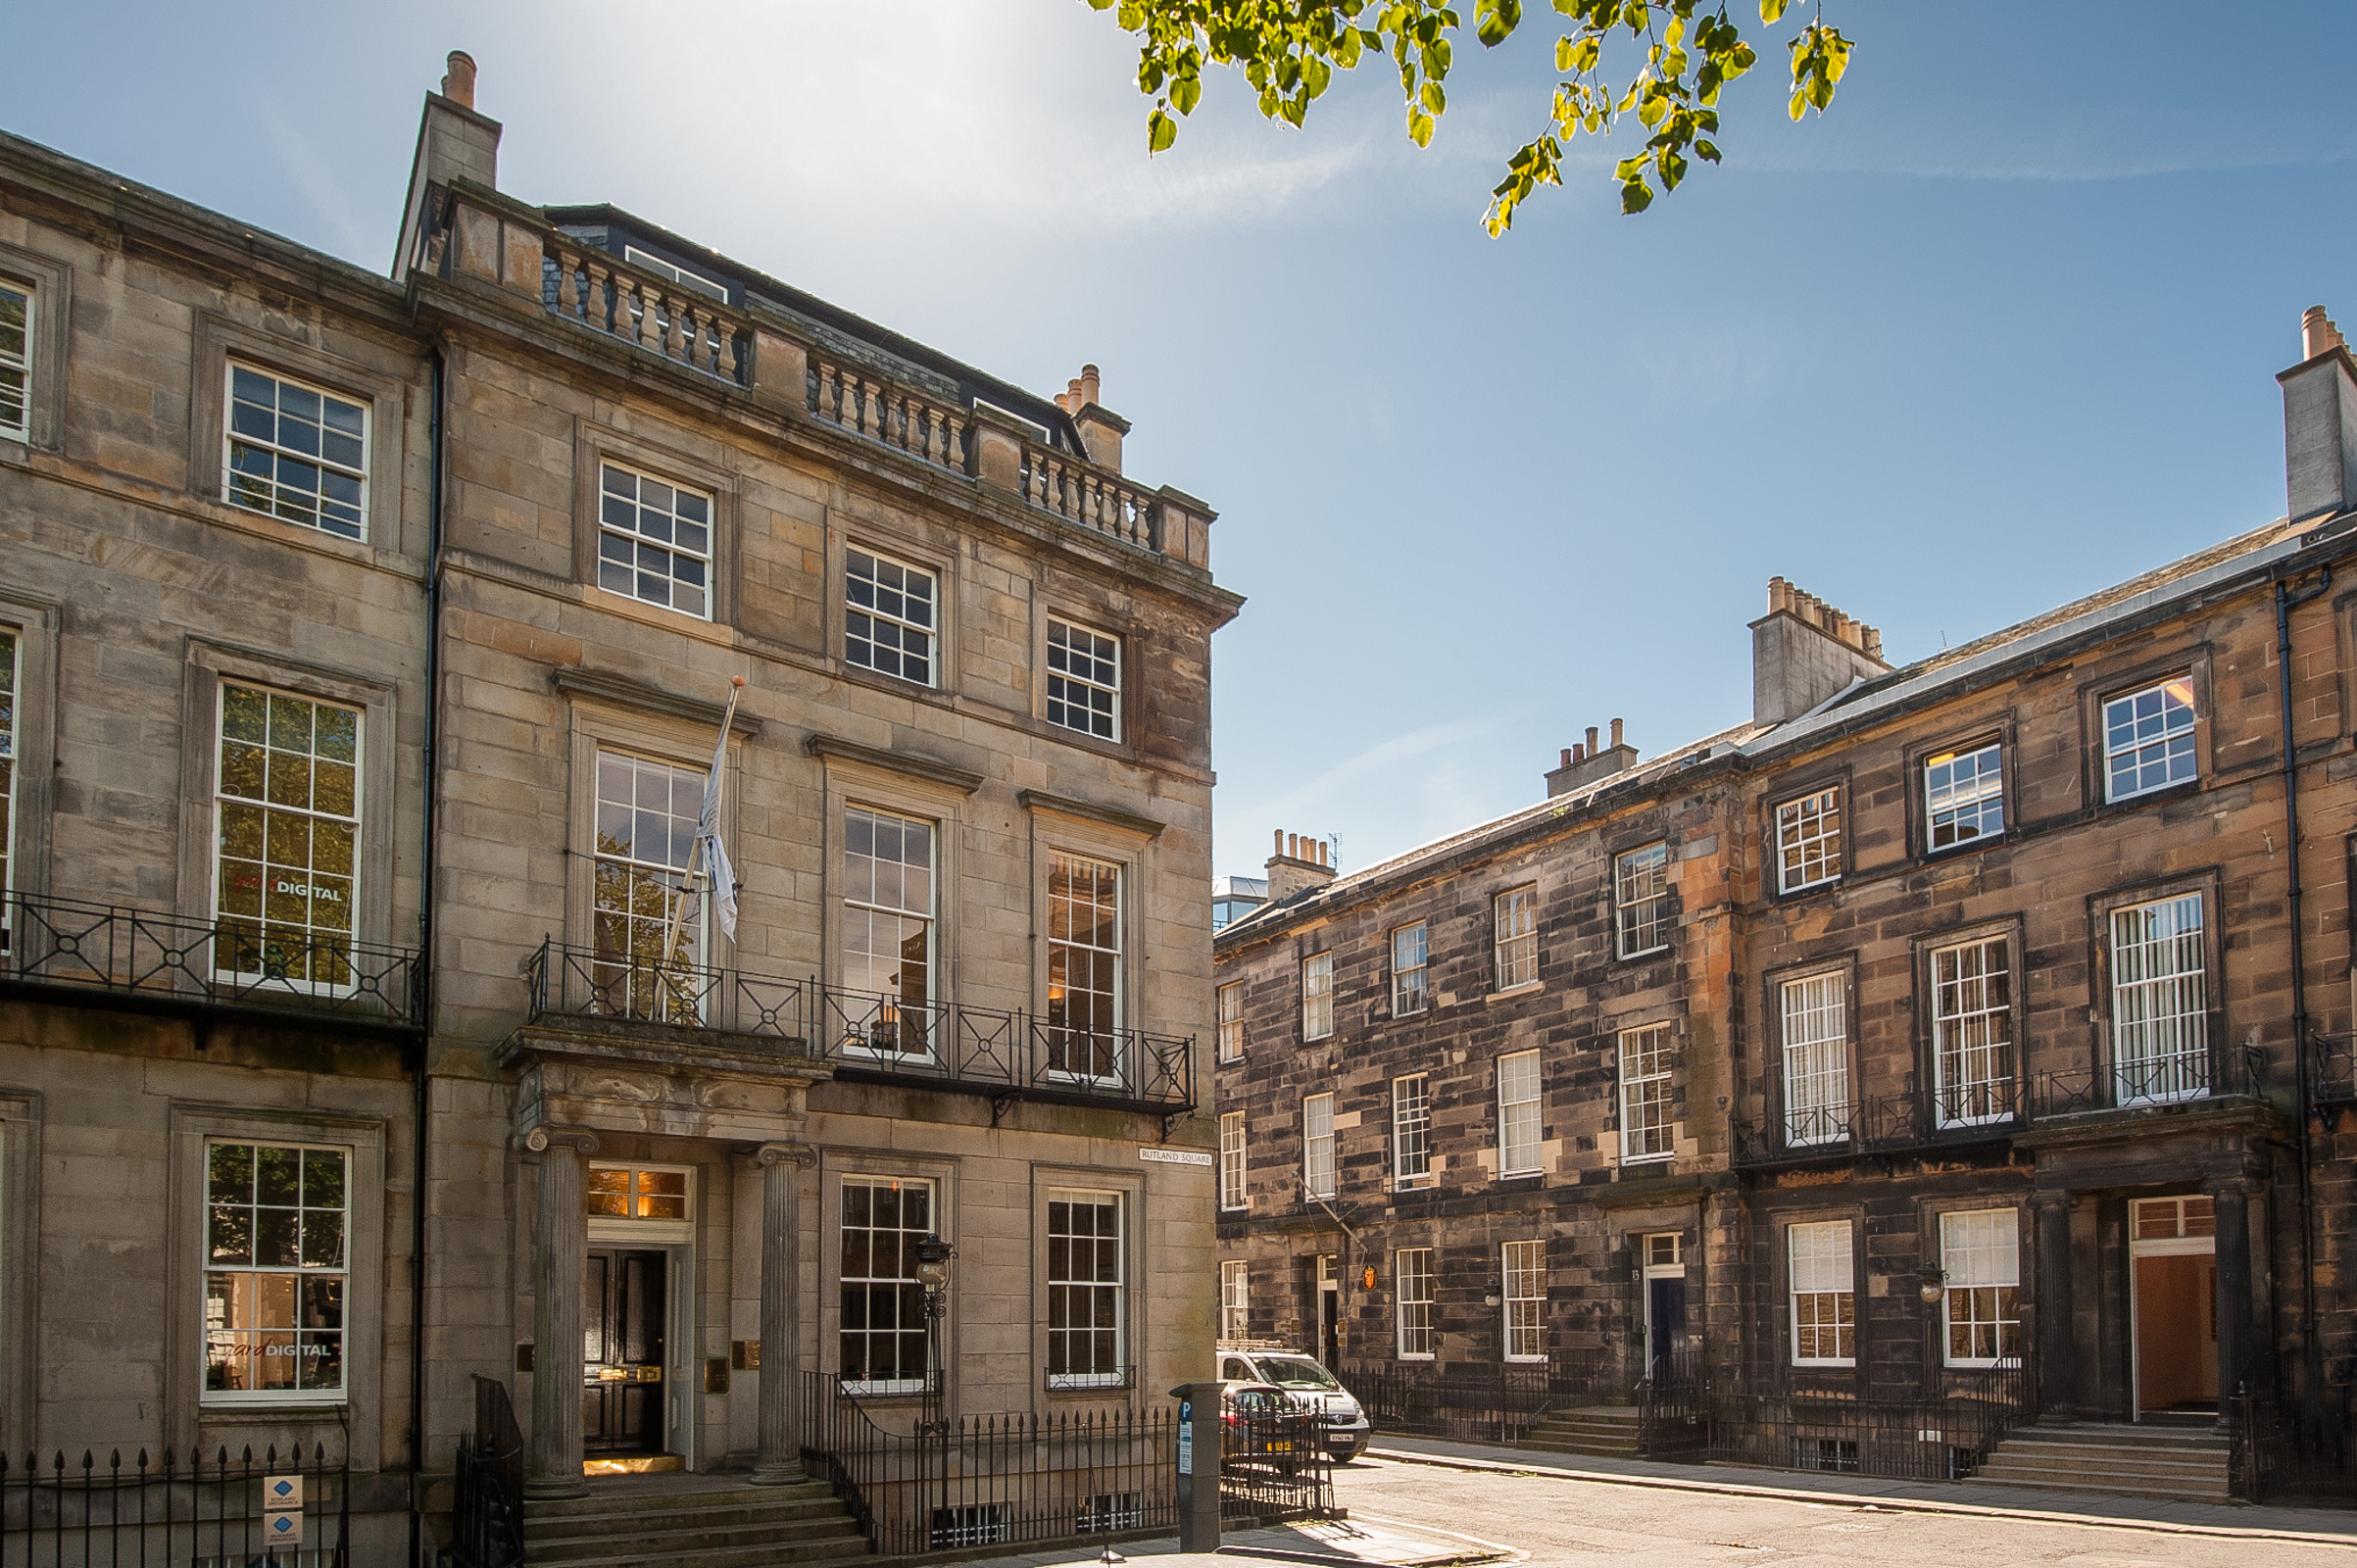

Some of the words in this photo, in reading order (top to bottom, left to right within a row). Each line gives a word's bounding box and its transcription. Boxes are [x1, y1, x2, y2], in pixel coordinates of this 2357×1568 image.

[277, 881, 342, 901] DIGTAL
[1142, 1150, 1178, 1160] RUTLAND
[1181, 1153, 1210, 1164] SQUARE
[266, 1345, 331, 1356] DIGTAL
[1183, 1401, 1192, 1418] P
